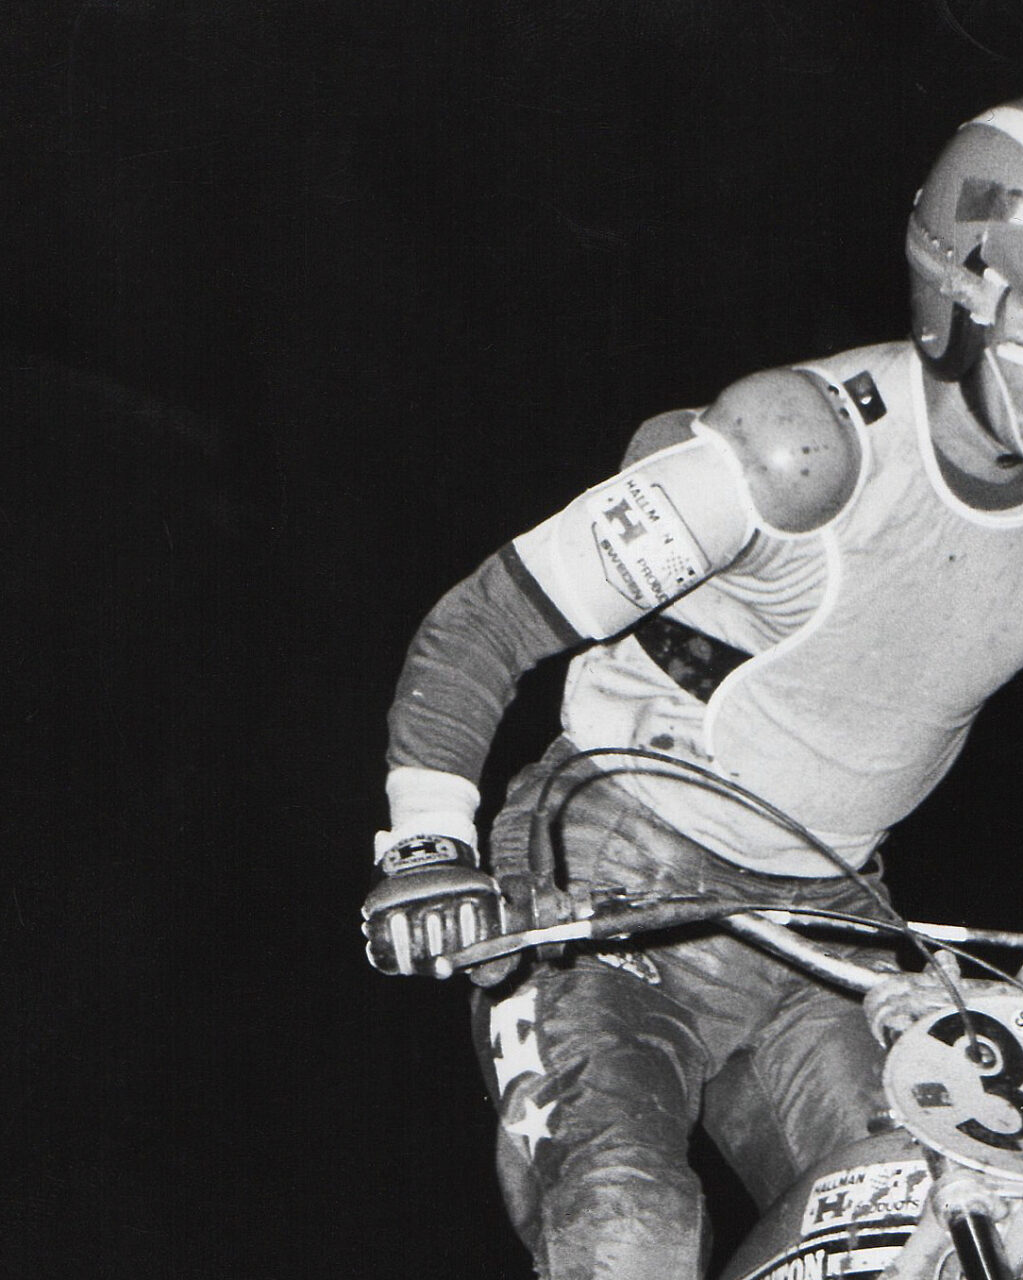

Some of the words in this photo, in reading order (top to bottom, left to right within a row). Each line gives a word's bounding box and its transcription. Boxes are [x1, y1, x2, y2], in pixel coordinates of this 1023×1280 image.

[602, 498, 648, 544] H
[626, 479, 674, 545] HALLMN
[814, 1173, 866, 1194] HALLMAN
[815, 1191, 849, 1223] H
